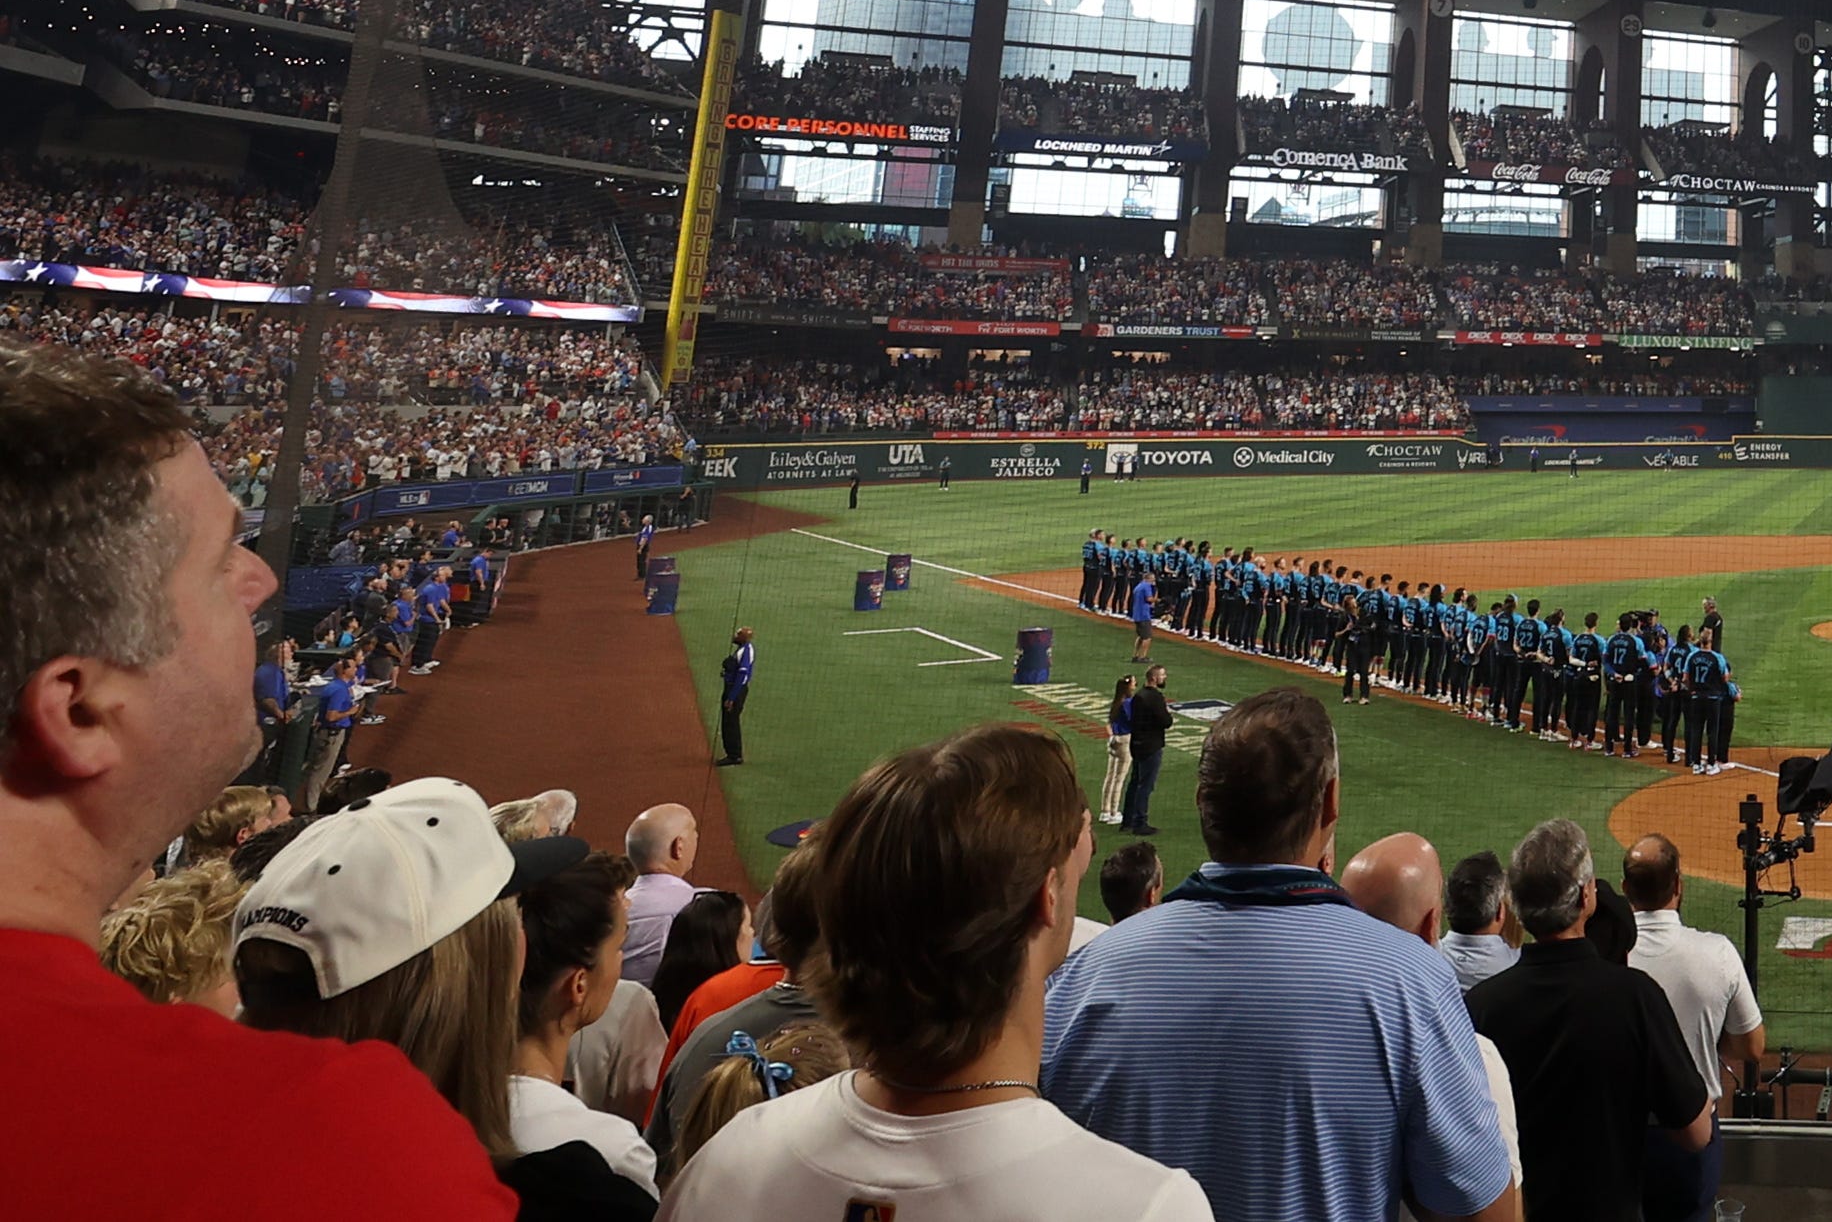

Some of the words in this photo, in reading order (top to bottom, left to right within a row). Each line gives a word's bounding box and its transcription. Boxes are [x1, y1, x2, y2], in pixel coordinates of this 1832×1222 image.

[1437, 0, 1446, 12] 7
[1624, 18, 1639, 32] 29
[724, 114, 782, 131] CORE
[786, 117, 908, 140] PERSONNEL
[909, 125, 951, 136] STAFFING
[909, 133, 950, 143] SERVICES
[1034, 139, 1102, 153] LOCKHEED
[1103, 143, 1153, 156] MARTIN
[1361, 152, 1409, 171] Bank
[1679, 174, 1756, 191] CHOCTAW
[1016, 327, 1048, 335] WORTH
[1116, 326, 1183, 336] GARDENERS
[1185, 327, 1220, 336] TRUST
[1467, 331, 1492, 339] DEX
[1500, 332, 1525, 340] DEX
[1532, 332, 1556, 341] DEX
[1564, 333, 1588, 341] DEX
[1632, 336, 1682, 349] LUXOR
[1686, 336, 1751, 350] STAFFING
[1375, 445, 1443, 457] CHOCTAW
[1750, 443, 1783, 452] ENERGY
[888, 444, 924, 465] UTA
[1141, 450, 1213, 465] TOYOTA
[1256, 449, 1306, 465] Medical
[1307, 449, 1335, 467] City
[1750, 452, 1790, 461] TRANSFER
[701, 456, 739, 478] EEK
[990, 457, 1061, 468] ESTRELLA
[995, 467, 1055, 477] JALISCO
